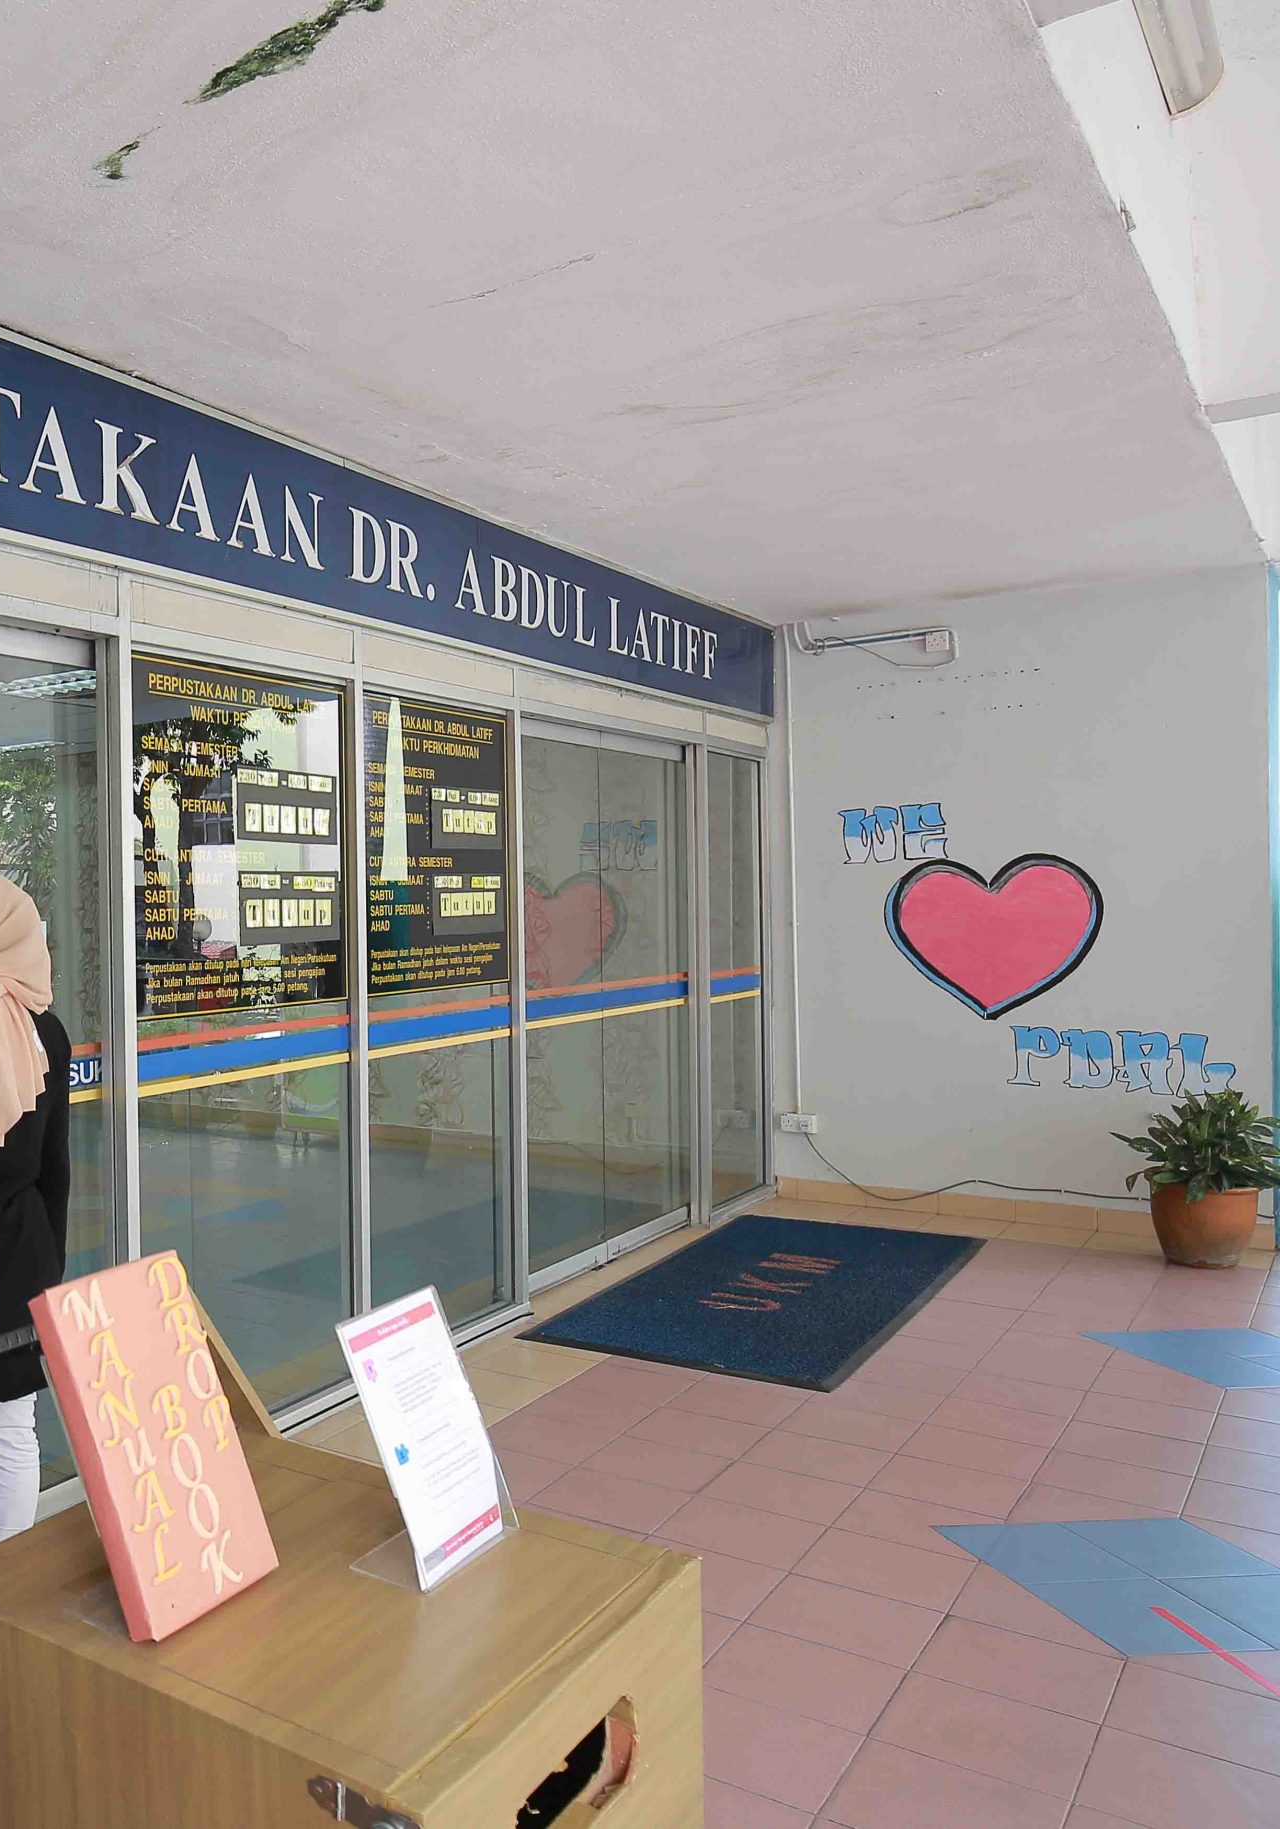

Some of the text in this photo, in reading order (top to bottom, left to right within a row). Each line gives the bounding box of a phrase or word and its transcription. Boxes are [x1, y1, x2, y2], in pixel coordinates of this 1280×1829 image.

[348, 506, 436, 601] DR.
[455, 548, 595, 649] ABDUL
[607, 597, 720, 680] LATIFF
[148, 672, 237, 701] PERPUSTAKAAN
[242, 688, 258, 704] DR.
[261, 691, 293, 710] ABDUL
[190, 705, 229, 725] WAKTU
[372, 710, 493, 741] PERUTAKAAN DR. ABDUL LATIFF
[141, 735, 184, 753] SEMASA
[390, 735, 480, 759] WKTU PERKHIDMATAN
[182, 798, 227, 814] PERTAMA
[370, 826, 387, 838] AHA
[838, 801, 949, 865] WE
[173, 848, 212, 864] NTARA
[369, 855, 386, 868] CUT
[418, 856, 453, 868] SEMESTER
[144, 871, 171, 886] ISNIN
[144, 889, 179, 904] SABTU
[369, 889, 394, 901] SABTU
[370, 904, 425, 917] SABTU PERTAMA
[441, 897, 492, 913] Tutup
[144, 908, 179, 923] SABTU
[145, 926, 175, 941] AHAD
[370, 920, 391, 932] AHAD
[145, 961, 186, 976] Perpustakaan
[188, 960, 202, 971] akan
[163, 976, 183, 988] bulan
[185, 974, 220, 986] Ramadhan
[145, 991, 194, 1006] Perpustakaan
[197, 989, 213, 1000] akan
[215, 987, 239, 1002] ditutup
[1007, 1025, 1237, 1099] PDAL
